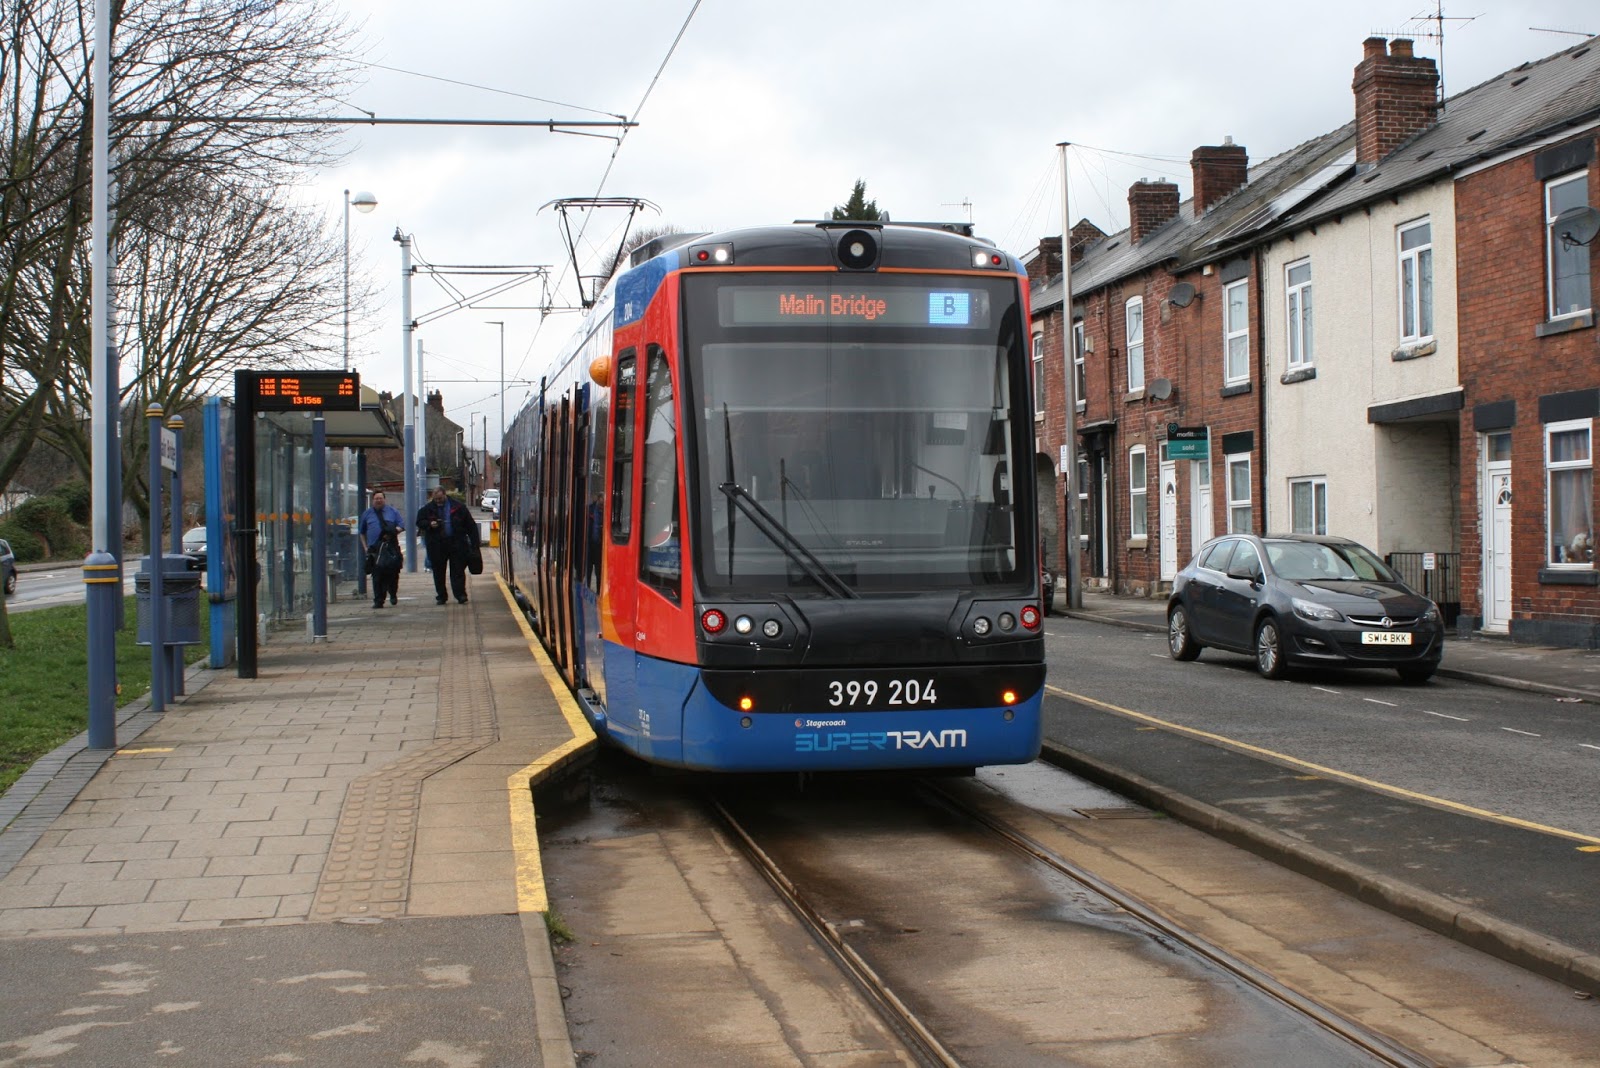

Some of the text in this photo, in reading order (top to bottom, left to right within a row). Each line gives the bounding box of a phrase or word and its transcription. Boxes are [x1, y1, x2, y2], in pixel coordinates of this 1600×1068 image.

[779, 294, 887, 320] Malin Bridge
[943, 296, 956, 316] B
[1367, 633, 1407, 643] SW14 BKK
[828, 679, 937, 707] 399 204
[805, 719, 846, 729] Stagecoach
[795, 729, 967, 752] SUPERTRAM
